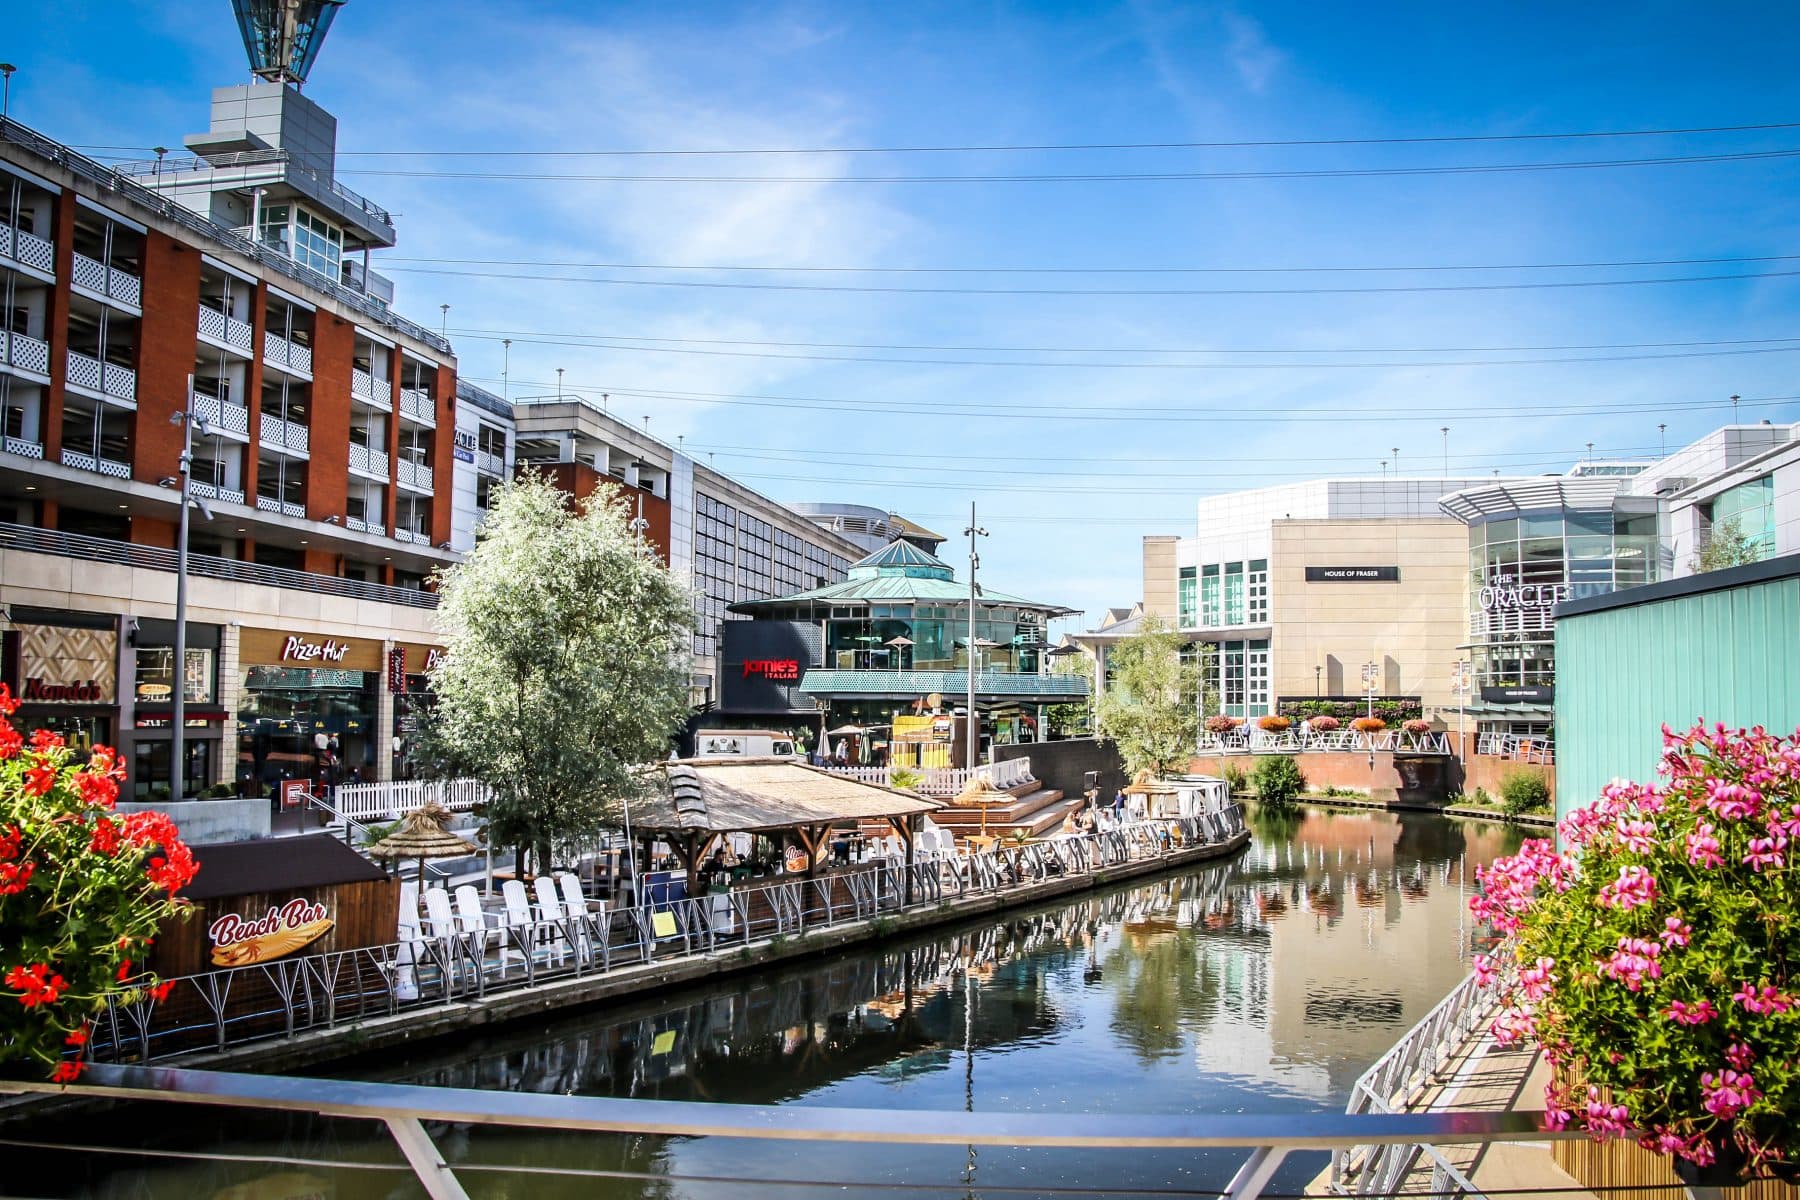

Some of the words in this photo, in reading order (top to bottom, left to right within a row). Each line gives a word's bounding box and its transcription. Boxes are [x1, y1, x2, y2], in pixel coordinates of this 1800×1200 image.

[1492, 573, 1513, 584] THE
[1479, 584, 1571, 609] ORACLE
[281, 636, 322, 661] Pizza
[321, 639, 350, 661] Hut
[24, 677, 101, 701] Nando's
[210, 906, 282, 947] Beach
[280, 898, 327, 929] Bar
